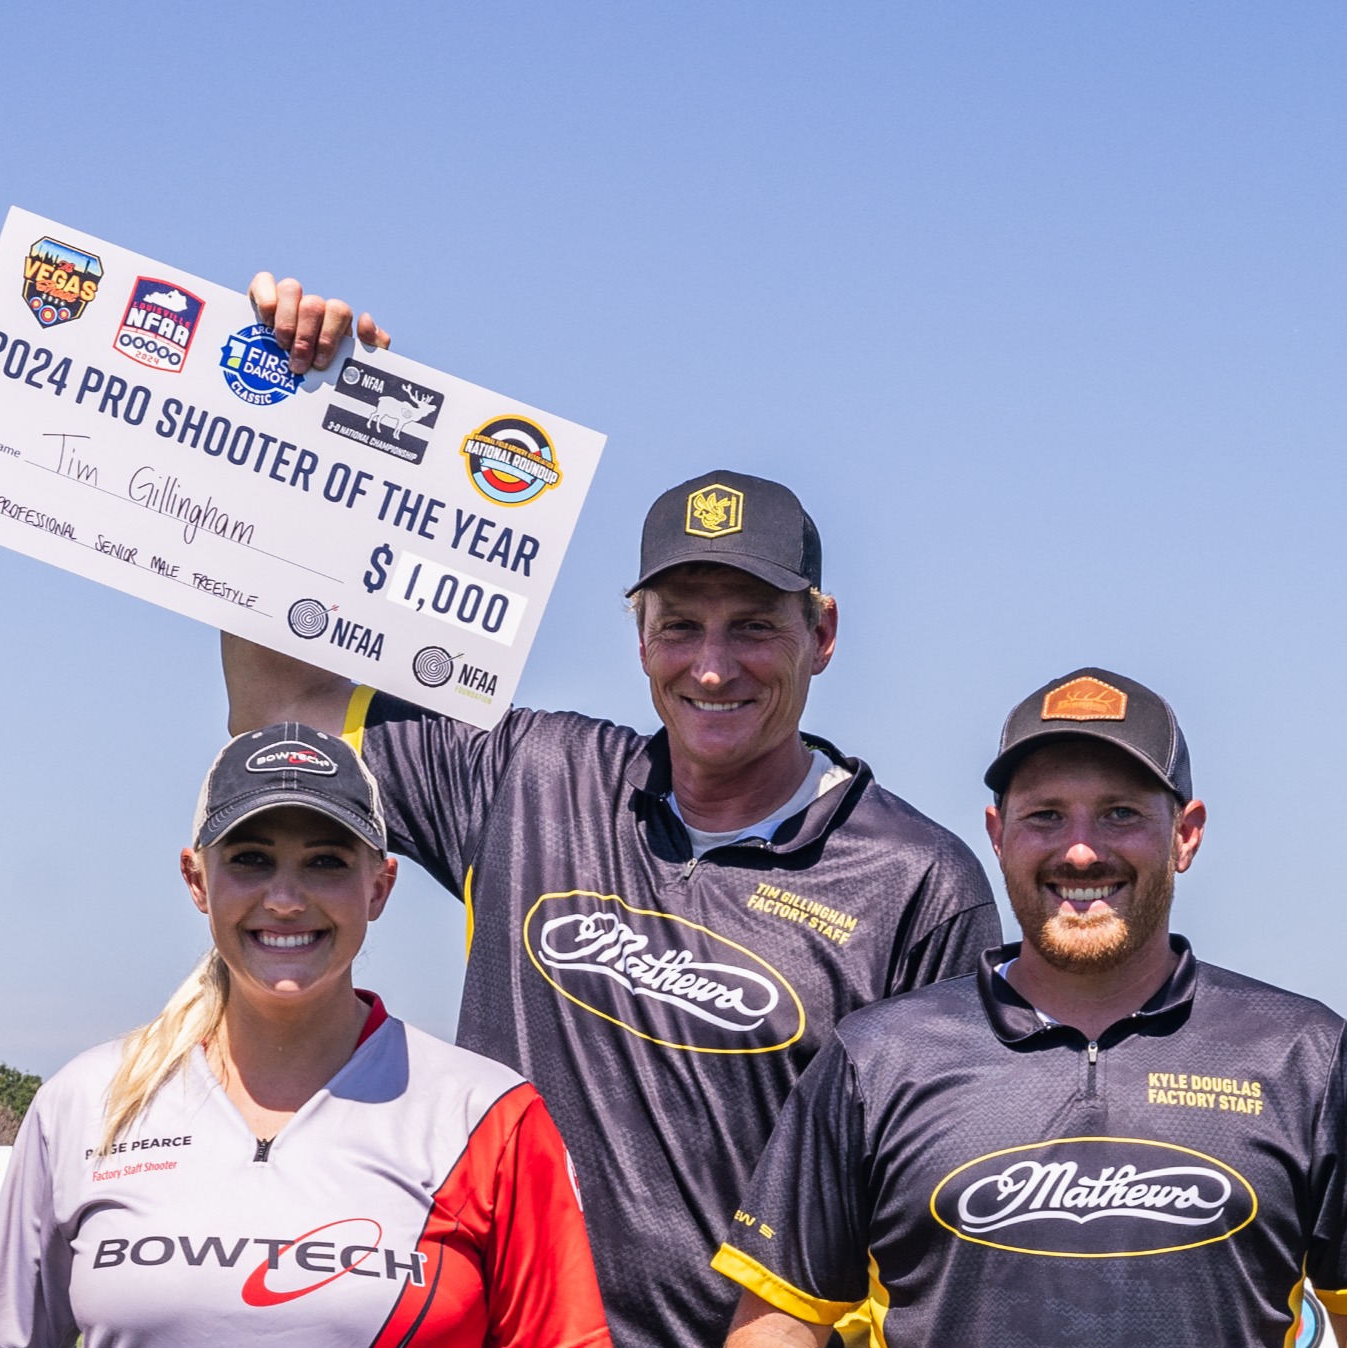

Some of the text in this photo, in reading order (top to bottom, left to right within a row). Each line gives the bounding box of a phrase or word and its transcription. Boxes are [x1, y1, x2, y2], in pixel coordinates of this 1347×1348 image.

[24, 257, 98, 302] VEGAS
[126, 307, 190, 347] NFAA
[43, 433, 254, 544] Tim Gillingham
[75, 366, 151, 425] PRO
[156, 398, 319, 491] SHOOTER
[323, 462, 373, 509] OF
[378, 480, 446, 540] THE
[451, 508, 540, 577] YEAR
[95, 535, 138, 565] SENIOR
[151, 556, 180, 578] MALE
[193, 573, 258, 608] FREESTYLE
[363, 543, 509, 633] $ 1,000
[329, 617, 385, 661] NFAA
[458, 663, 498, 696] NFAA
[256, 751, 329, 768] BOWTECH
[747, 894, 851, 945] FACTORY STAFF
[756, 883, 858, 932] TIM GILLINGHAM
[539, 912, 780, 1031] Mathews
[1148, 1073, 1261, 1099] KYLE DOUGLAS
[1148, 1089, 1262, 1116] FACTORY STAFF
[131, 1136, 192, 1151] PEARCE
[92, 1160, 178, 1182] Factory Staff Shooter
[958, 1161, 1231, 1233] Mathews
[93, 1235, 425, 1286] BOWTECH
